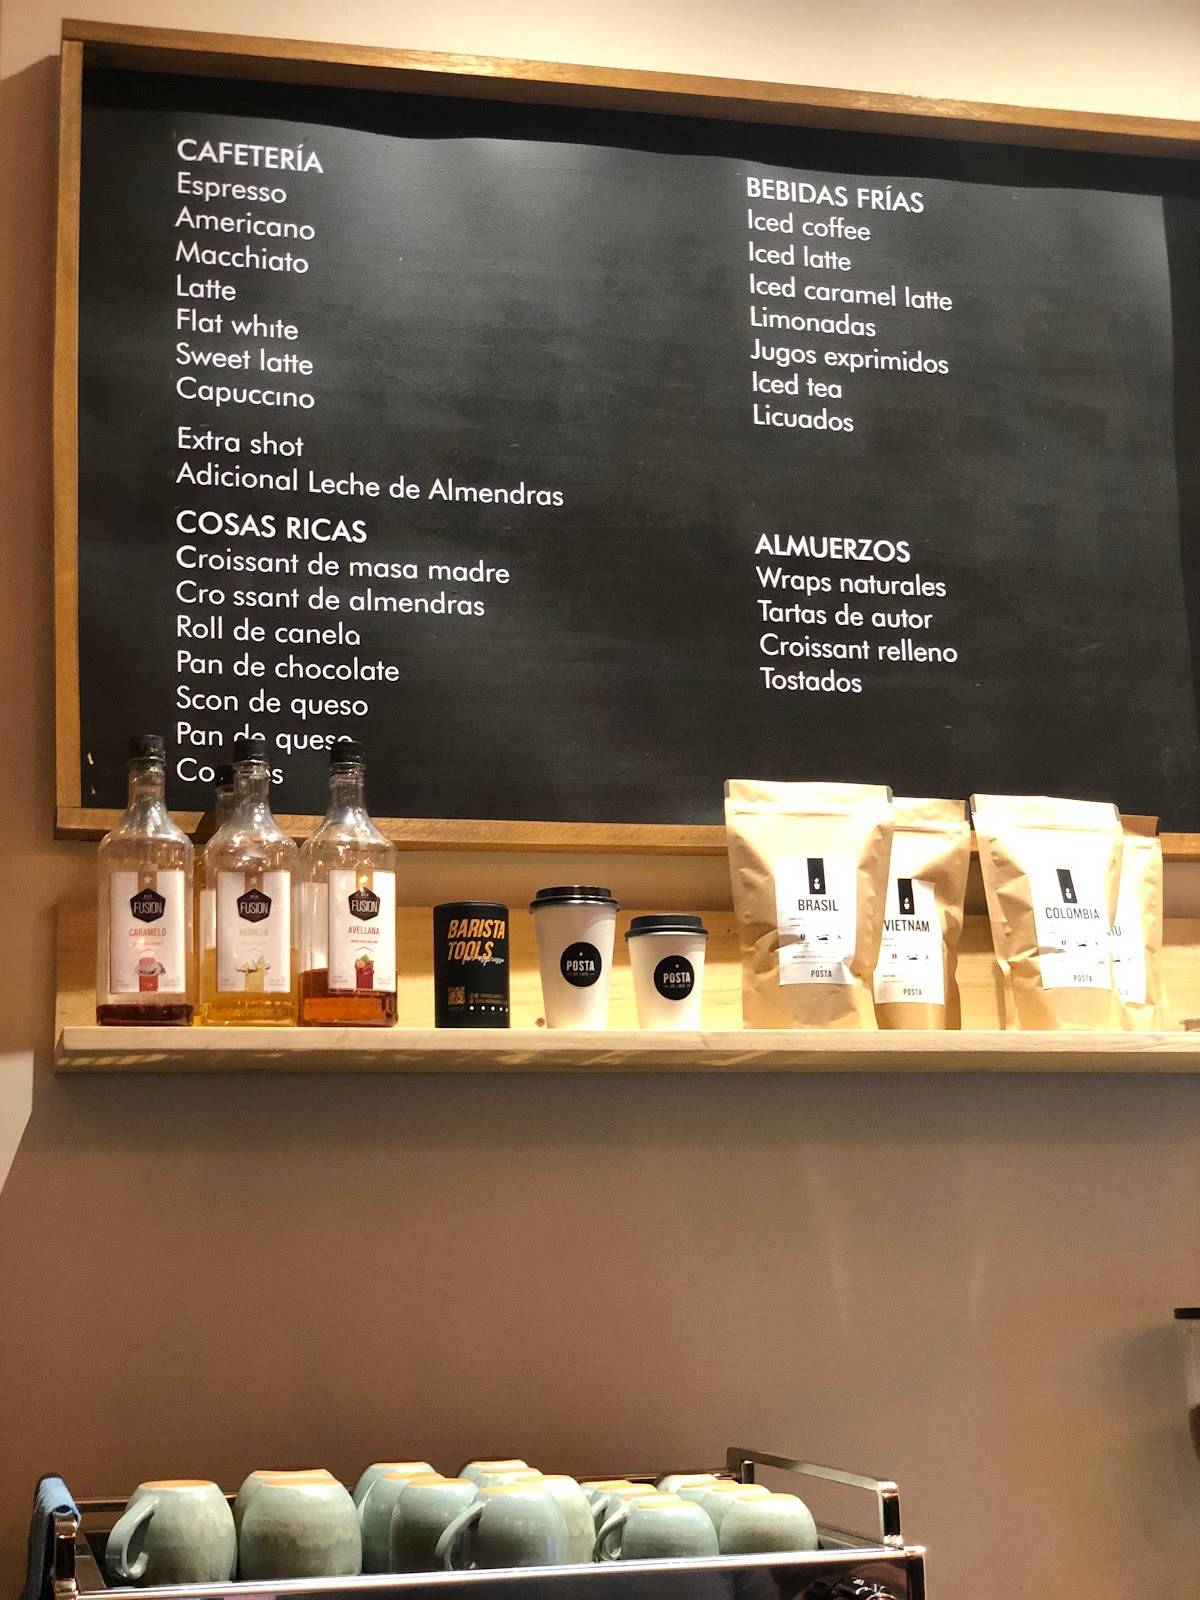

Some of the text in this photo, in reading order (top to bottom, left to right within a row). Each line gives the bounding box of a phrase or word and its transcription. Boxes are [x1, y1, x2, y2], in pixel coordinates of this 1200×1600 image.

[176, 138, 324, 174] CAFETERÍA
[177, 171, 287, 204] Espresso
[746, 176, 925, 214] BEBIDAS FRÍAS
[174, 205, 316, 241] Americano
[747, 208, 871, 242] Iced coffee
[175, 239, 309, 274] Macchiato
[748, 240, 852, 272] Iced latte
[176, 273, 237, 302] Latte
[749, 272, 953, 311] Iced caramel latte
[176, 307, 299, 341] Flat white
[750, 305, 877, 338] Limonadas
[175, 341, 314, 376] Sweet latte
[749, 338, 950, 375] Jugos exprimidos
[175, 375, 315, 409] Capuccino
[752, 370, 843, 399] Iced tea
[753, 403, 855, 433] Licuados
[177, 425, 305, 457] Extra shot
[175, 461, 564, 507] Adicional Leche de Almendras
[175, 509, 368, 544] COSAS RICAS
[175, 544, 510, 584] Croissant de masa madre
[754, 532, 911, 564] ALMUERZOS
[755, 565, 947, 598] Wraps naturales
[307, 585, 340, 611] de
[349, 587, 485, 617] almendras
[756, 598, 934, 630] Tartas de autor
[176, 614, 361, 646] Roll de canela
[759, 632, 959, 663] Croissant relleno
[176, 649, 400, 682] Pan de chocolate
[759, 666, 863, 694] Tostados
[175, 684, 369, 721] Scon de queso
[176, 720, 224, 747] Pan
[133, 901, 163, 914] FUSION
[240, 901, 269, 915] FUSION
[351, 899, 378, 913] FUSION
[797, 899, 839, 912] BRASIL
[1045, 907, 1101, 920] COLOMBIA
[128, 927, 167, 937] CARAMELO
[348, 925, 380, 936] AVELLANA
[447, 918, 506, 940] BARISTA
[883, 919, 930, 933] VIETNAM
[447, 940, 495, 961] TOOLS
[566, 959, 596, 972] POSTA
[662, 971, 692, 984] POSTA
[810, 969, 833, 978] POSTA
[903, 988, 923, 996] POSTA
